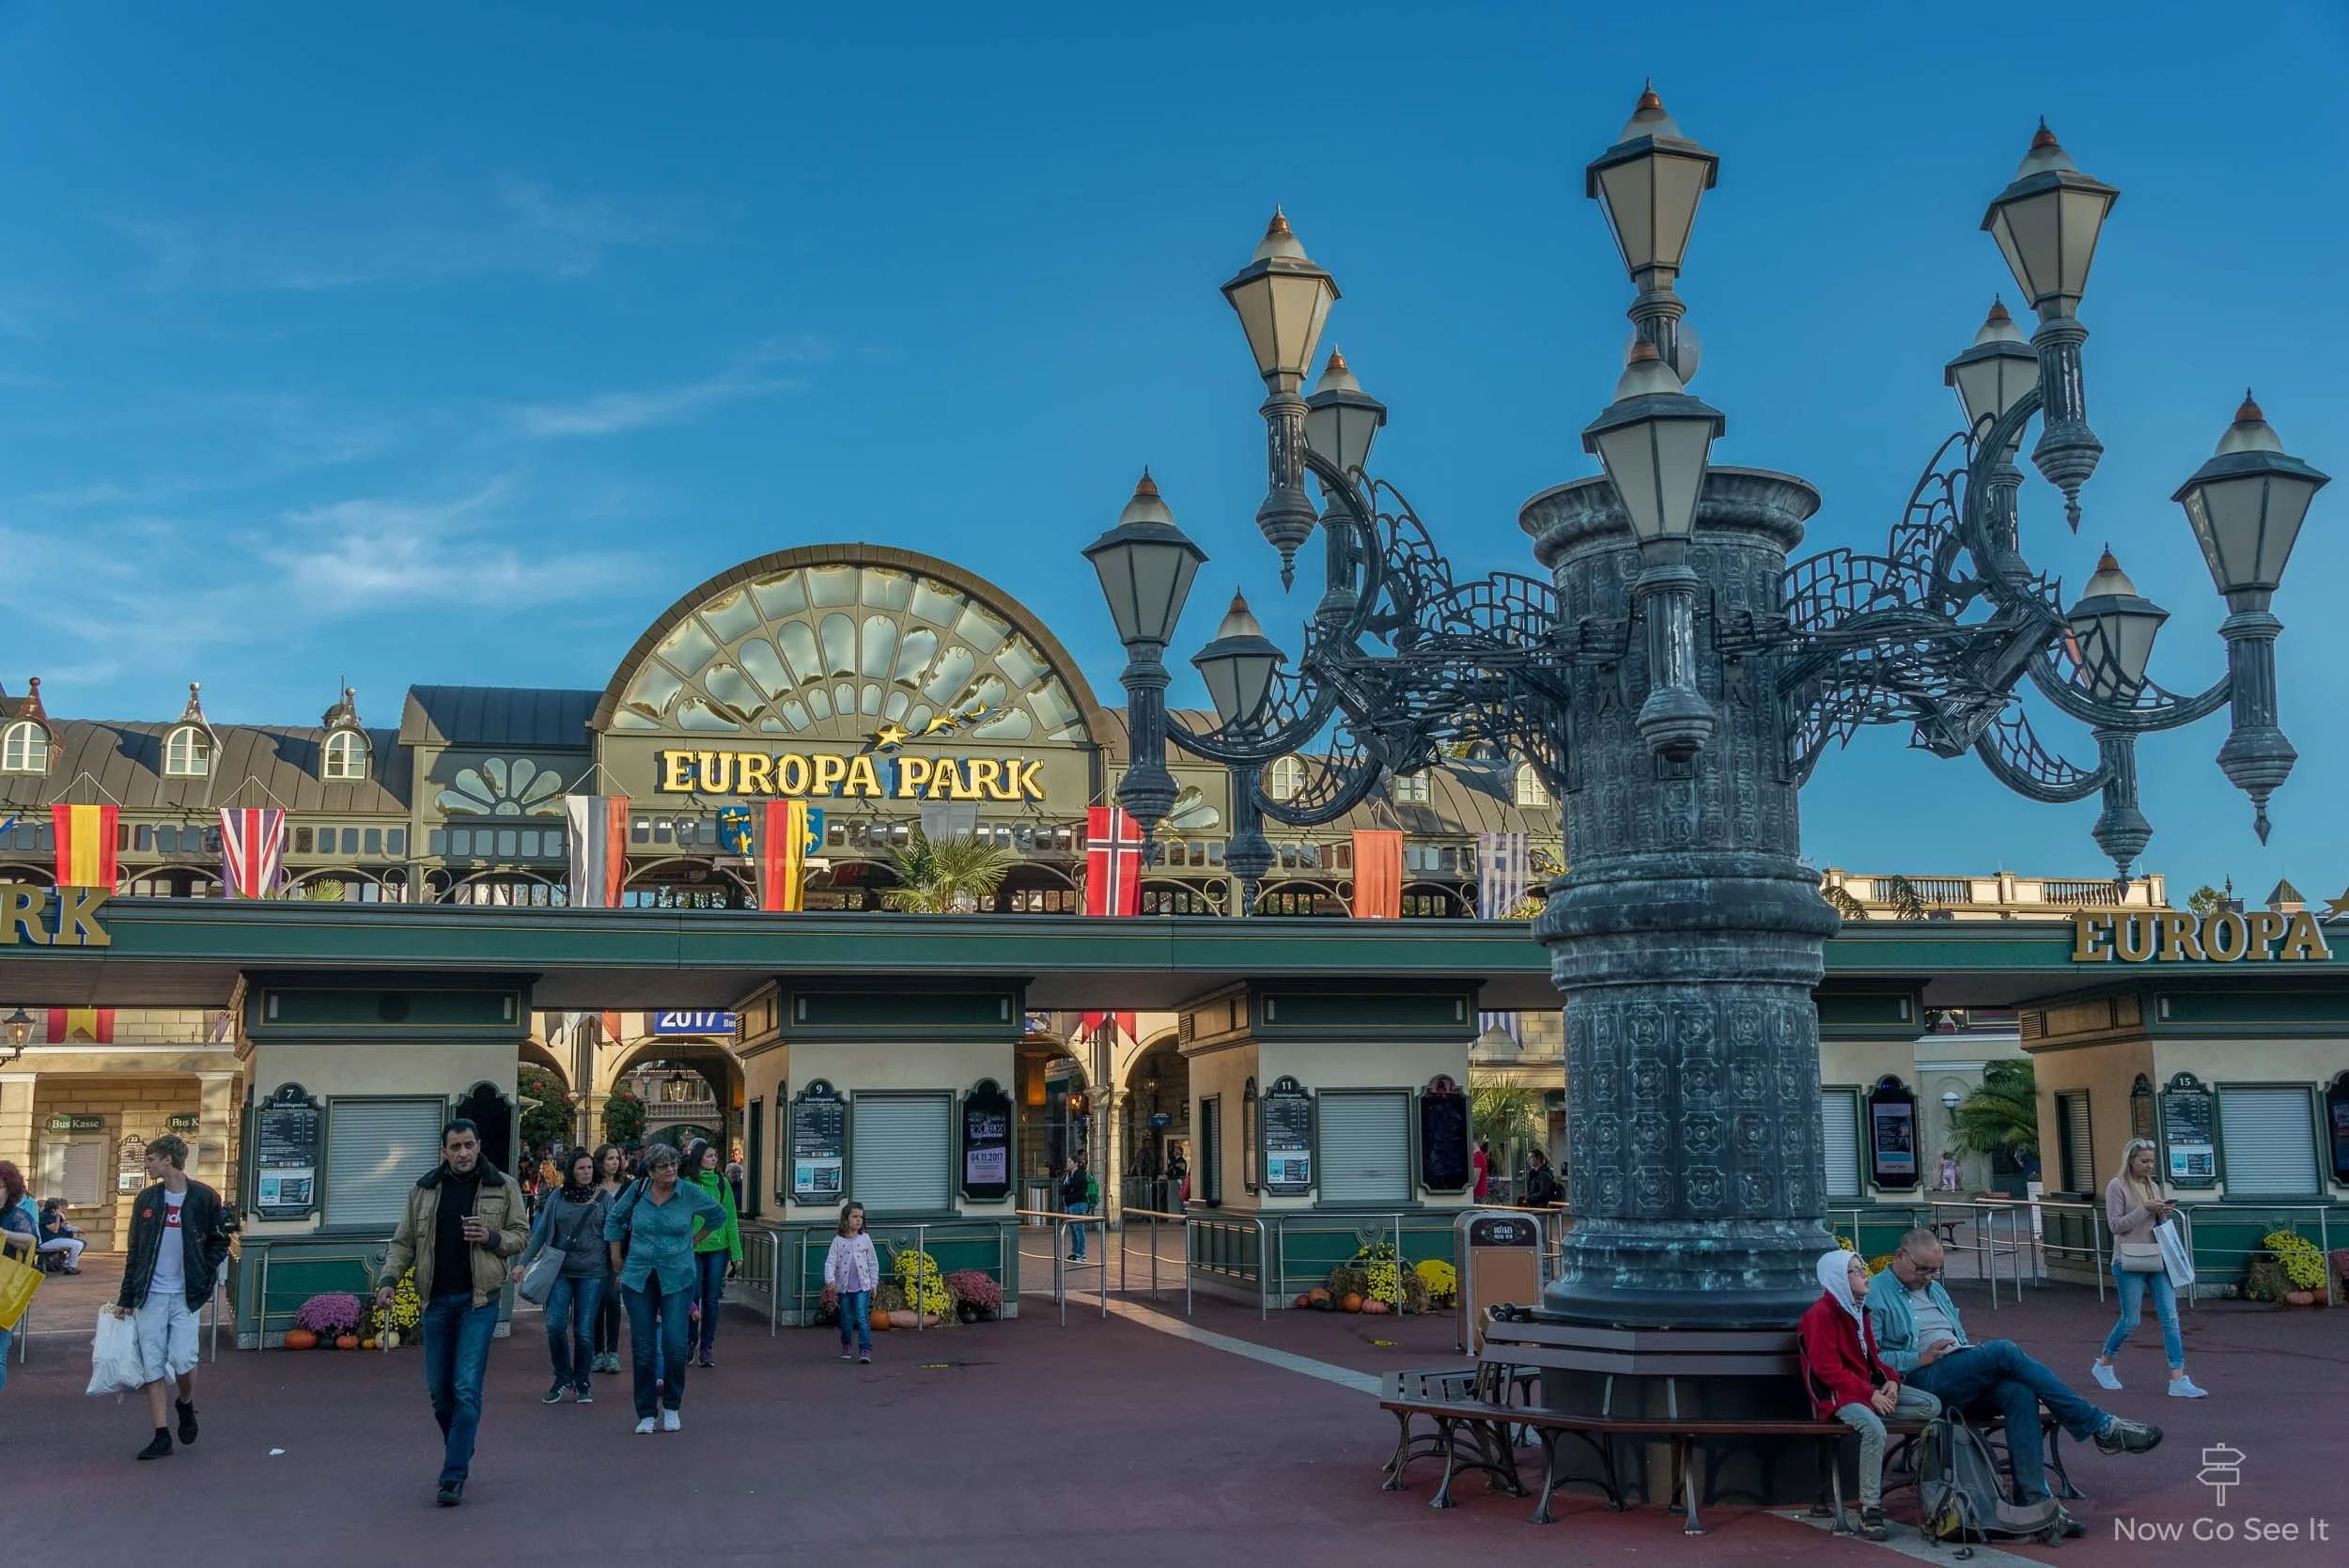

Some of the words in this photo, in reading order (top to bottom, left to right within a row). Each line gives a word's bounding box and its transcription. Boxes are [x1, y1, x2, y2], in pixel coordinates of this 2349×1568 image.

[661, 750, 883, 797] EUROPA
[897, 755, 1046, 800] PARK
[0, 884, 112, 945] RK
[2072, 912, 2333, 962] EUROPA
[661, 1012, 716, 1028] 2017
[1281, 1081, 1292, 1090] 11
[2179, 1078, 2191, 1086] 15
[286, 1089, 294, 1099] 7
[816, 1084, 823, 1094] 9
[52, 1120, 70, 1128] Bus
[72, 1120, 100, 1128] Kasse
[172, 1118, 190, 1126] Bus
